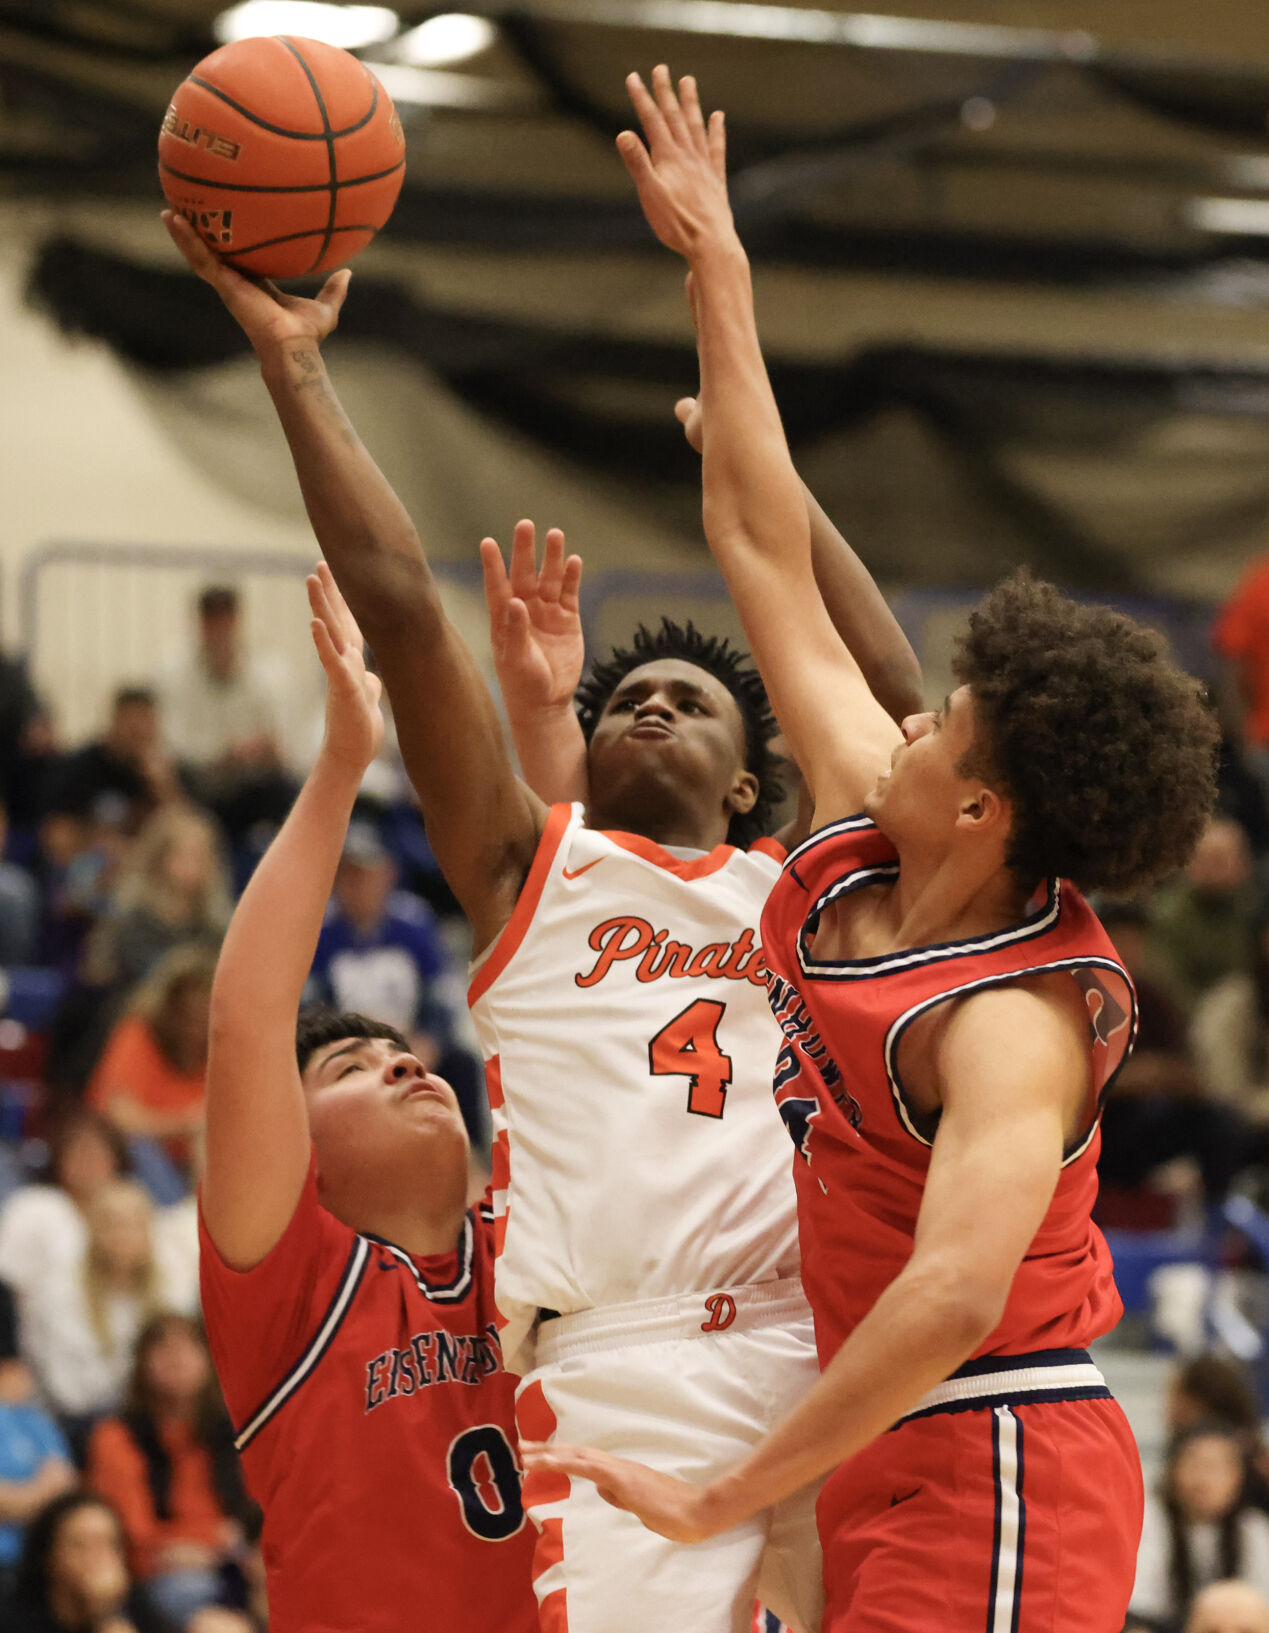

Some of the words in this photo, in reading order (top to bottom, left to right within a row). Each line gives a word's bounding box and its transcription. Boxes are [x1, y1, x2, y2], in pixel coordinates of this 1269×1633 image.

[648, 997, 733, 1120] 4
[701, 1293, 737, 1332] D
[446, 1424, 527, 1542] 0
